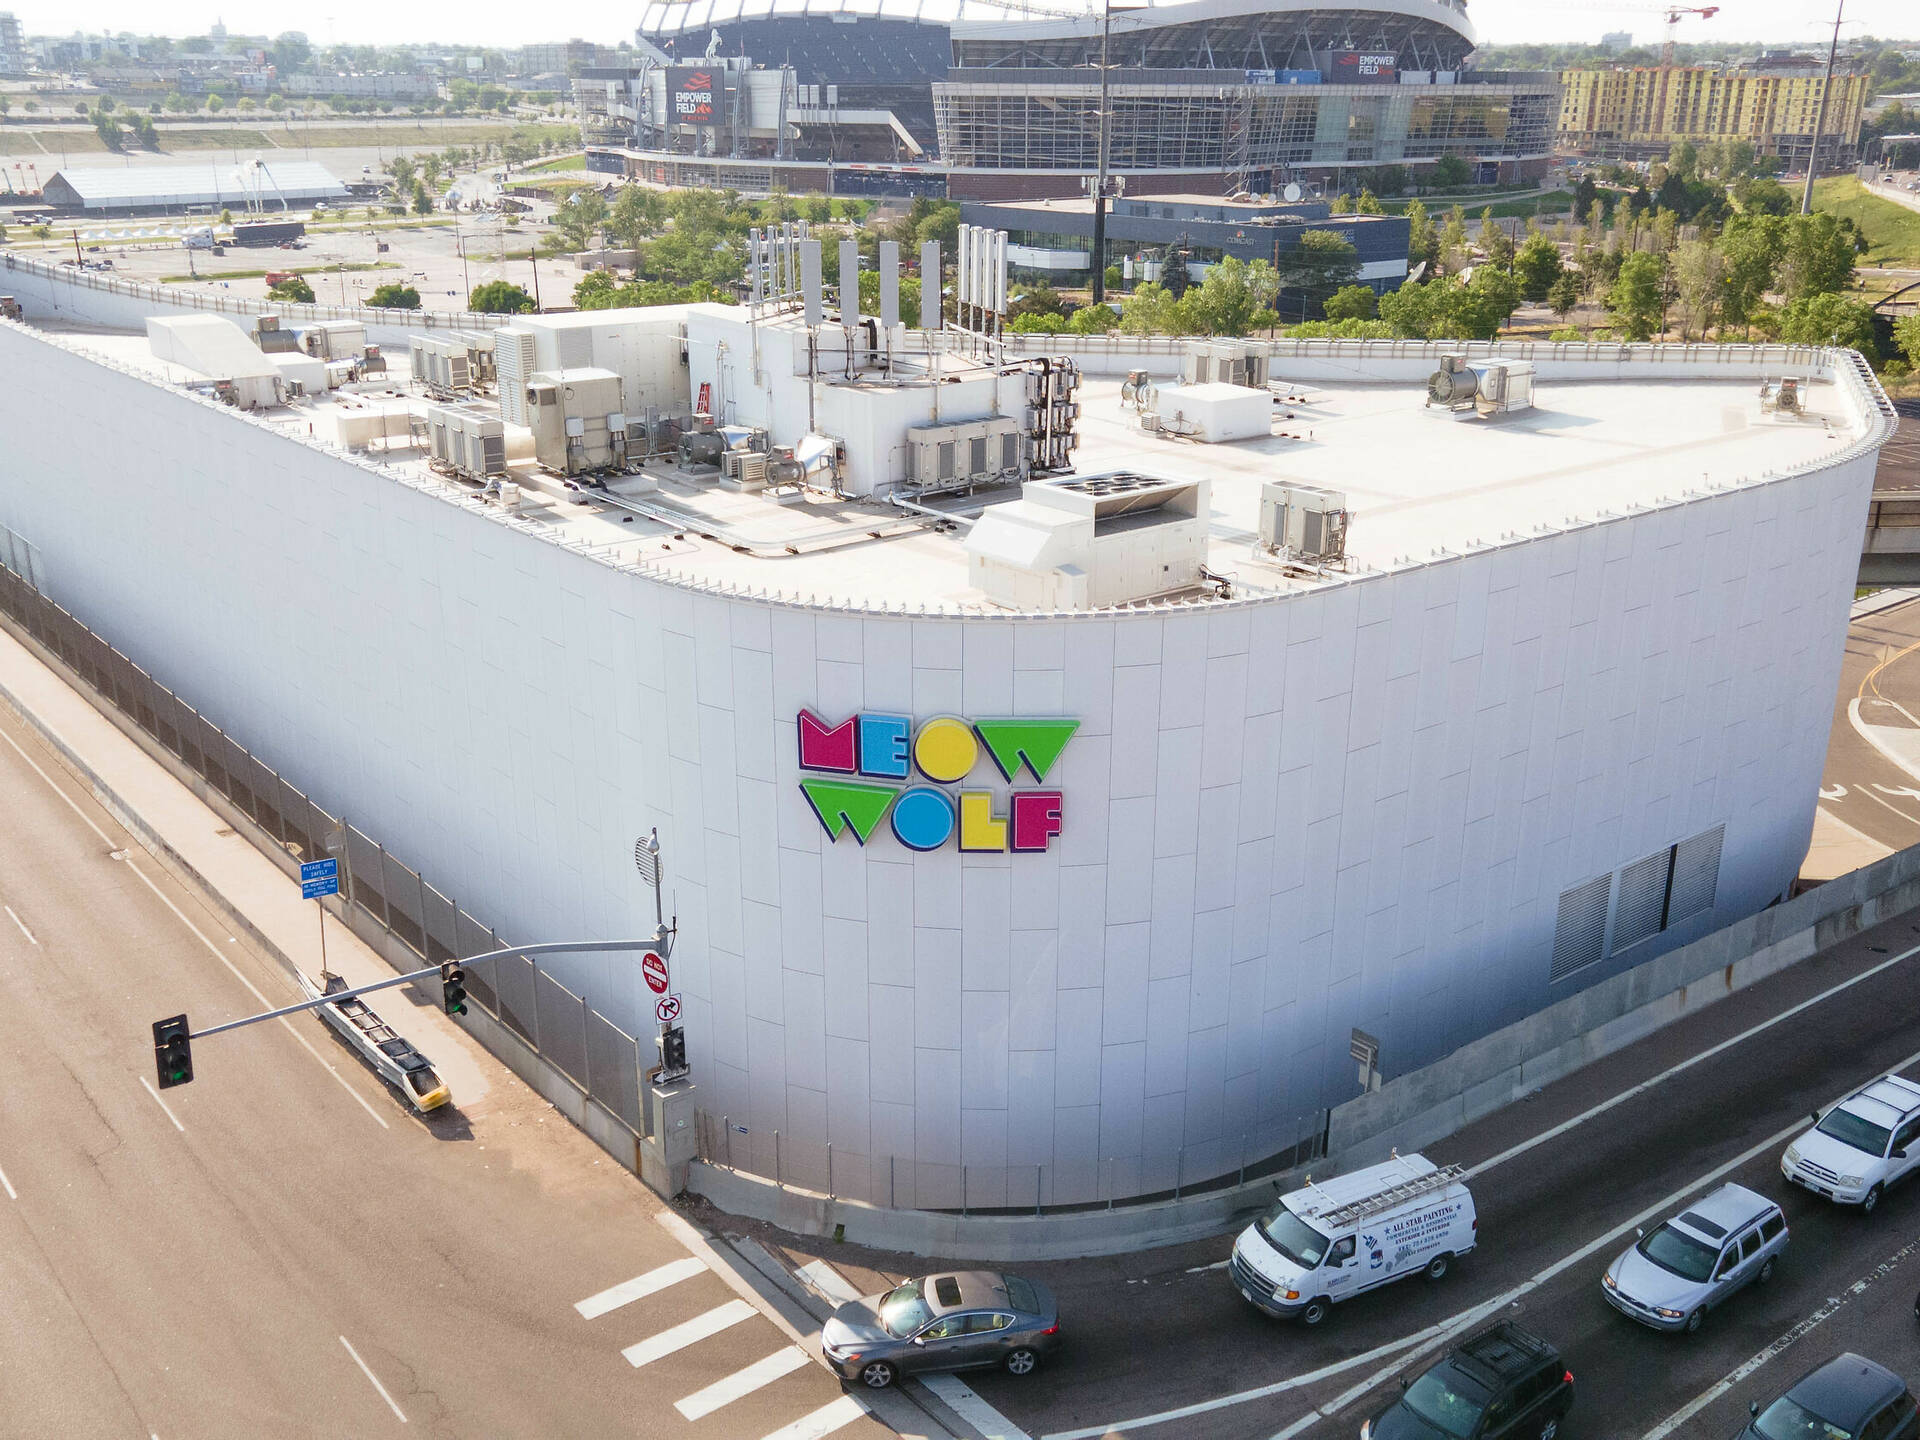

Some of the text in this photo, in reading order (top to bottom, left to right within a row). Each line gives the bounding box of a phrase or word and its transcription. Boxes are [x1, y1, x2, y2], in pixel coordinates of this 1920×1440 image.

[1359, 55, 1395, 66] EMPOWER
[1358, 65, 1379, 75] FIELD
[675, 91, 712, 104] EMPOWER
[676, 103, 696, 114] FIELD
[797, 708, 1081, 786] MEOW
[799, 778, 1063, 853] WOLF
[646, 958, 663, 971] DO NOT
[648, 976, 662, 988] ENTER
[1393, 1205, 1454, 1232] ALL STAR PAINTING
[1386, 1227, 1420, 1240] COMMERCIAL
[1426, 1222, 1450, 1234] INTERIOR
